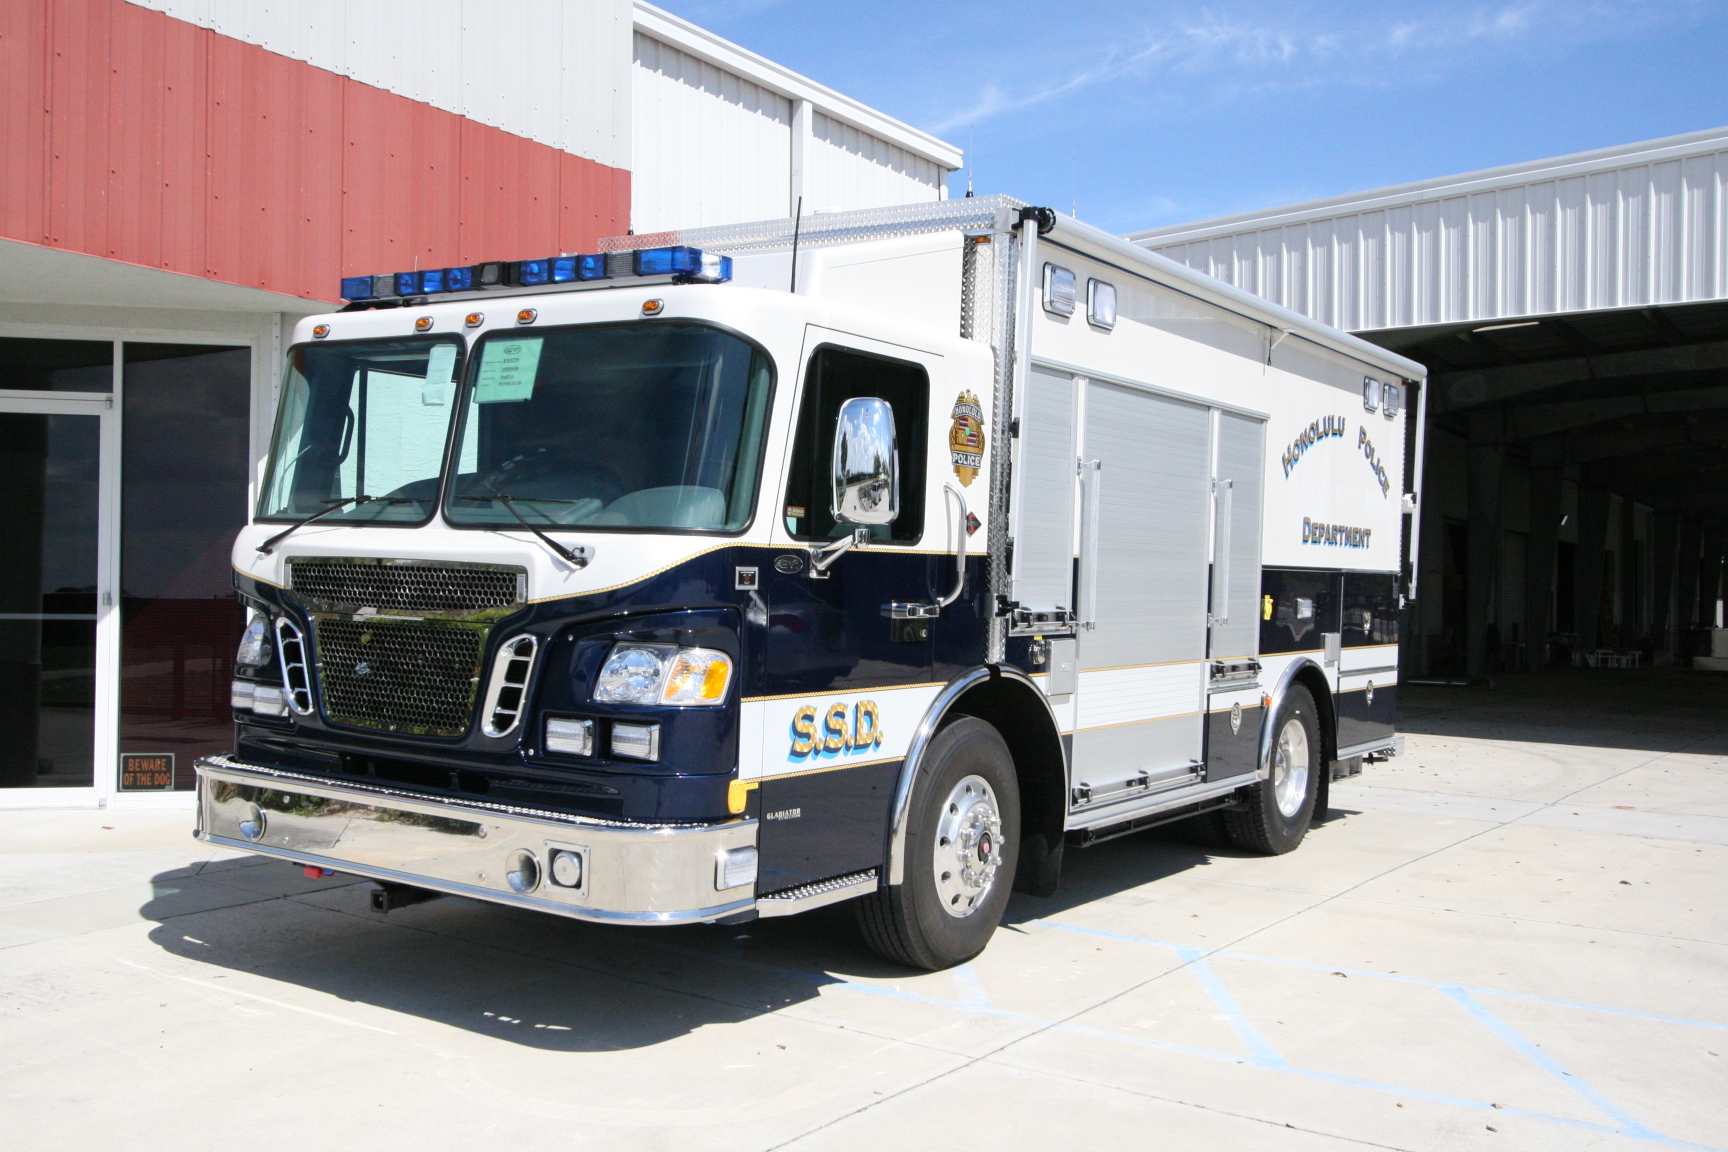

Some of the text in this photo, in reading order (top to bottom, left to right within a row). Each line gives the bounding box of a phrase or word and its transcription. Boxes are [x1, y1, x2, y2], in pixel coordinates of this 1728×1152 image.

[954, 404, 982, 420] HONOLULU
[952, 452, 981, 467] POLICE
[1282, 415, 1390, 499] HONOLULU POLICE
[1302, 516, 1371, 549] DEPARTMENT
[787, 700, 884, 764] S.S.D.
[128, 758, 167, 772] BEWARE
[123, 772, 171, 786] OF THE DOG
[766, 807, 801, 820] GLADIATOR
